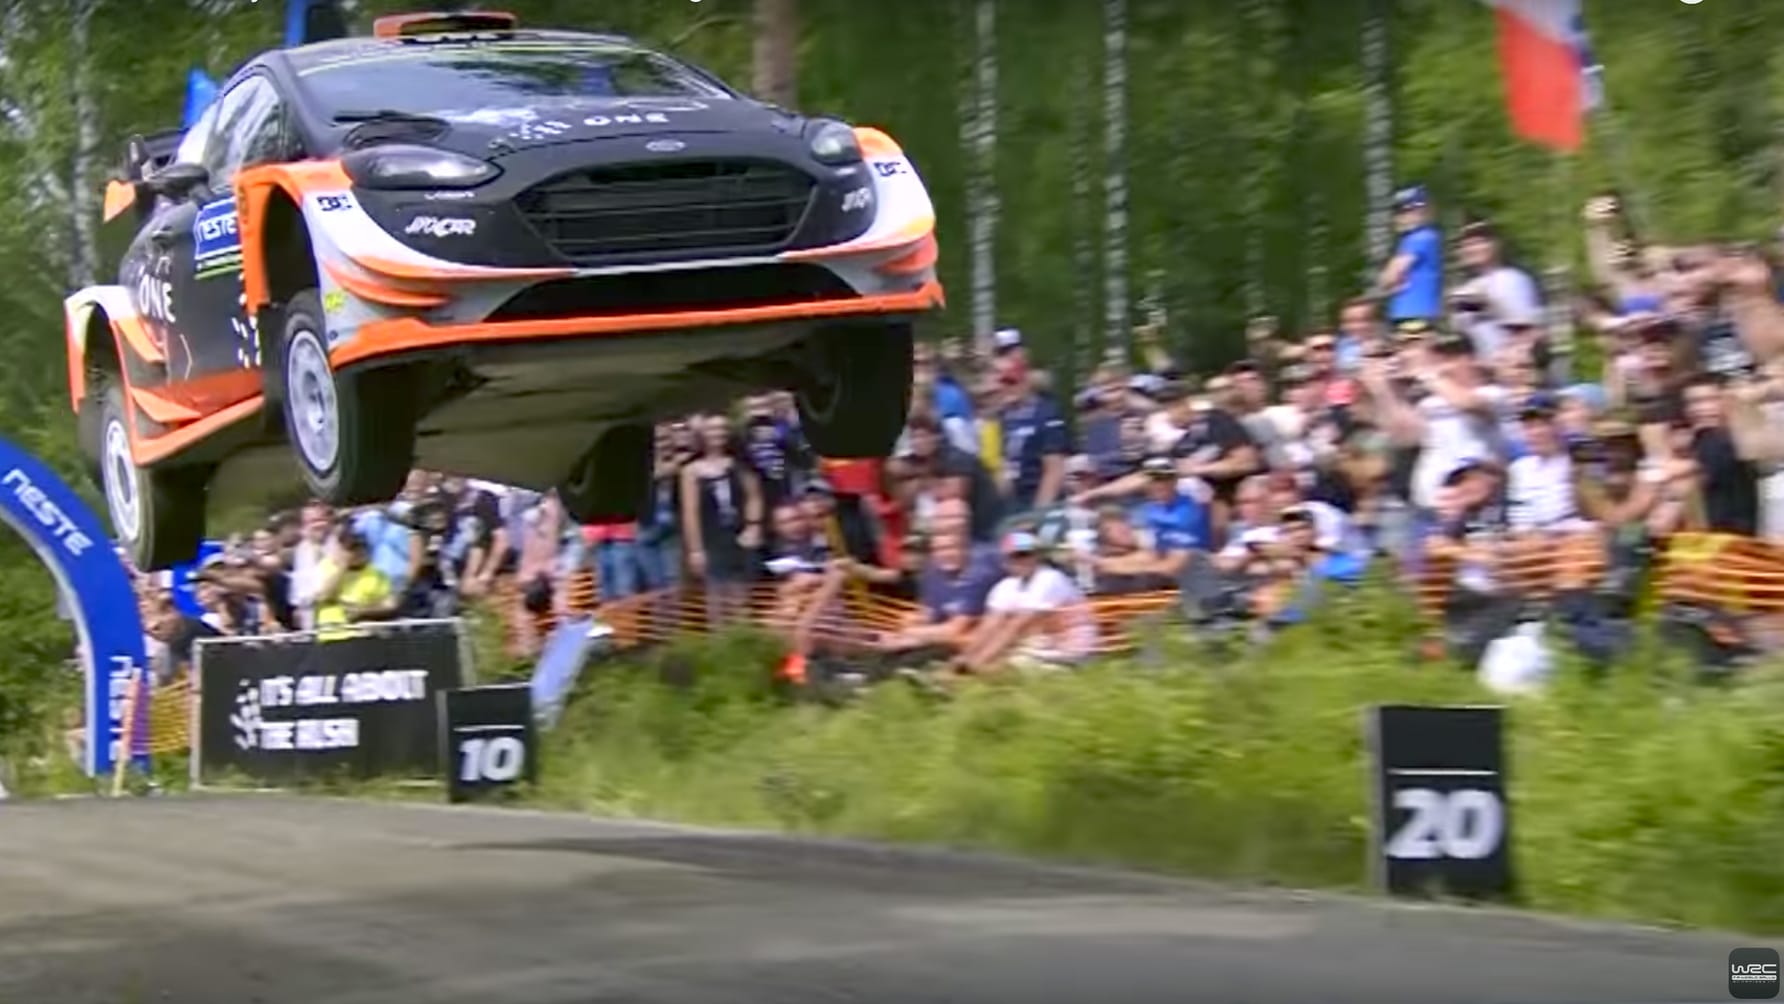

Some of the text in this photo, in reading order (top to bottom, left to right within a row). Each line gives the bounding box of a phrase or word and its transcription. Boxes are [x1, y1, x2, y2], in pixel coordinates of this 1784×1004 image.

[583, 113, 670, 126] ONE
[139, 273, 176, 323] ONE
[2, 468, 94, 556] NESTE
[295, 675, 339, 705] ALL
[341, 669, 428, 702] ABOUT
[260, 721, 295, 750] THE
[458, 736, 525, 782] 10
[1384, 787, 1503, 860] 20
